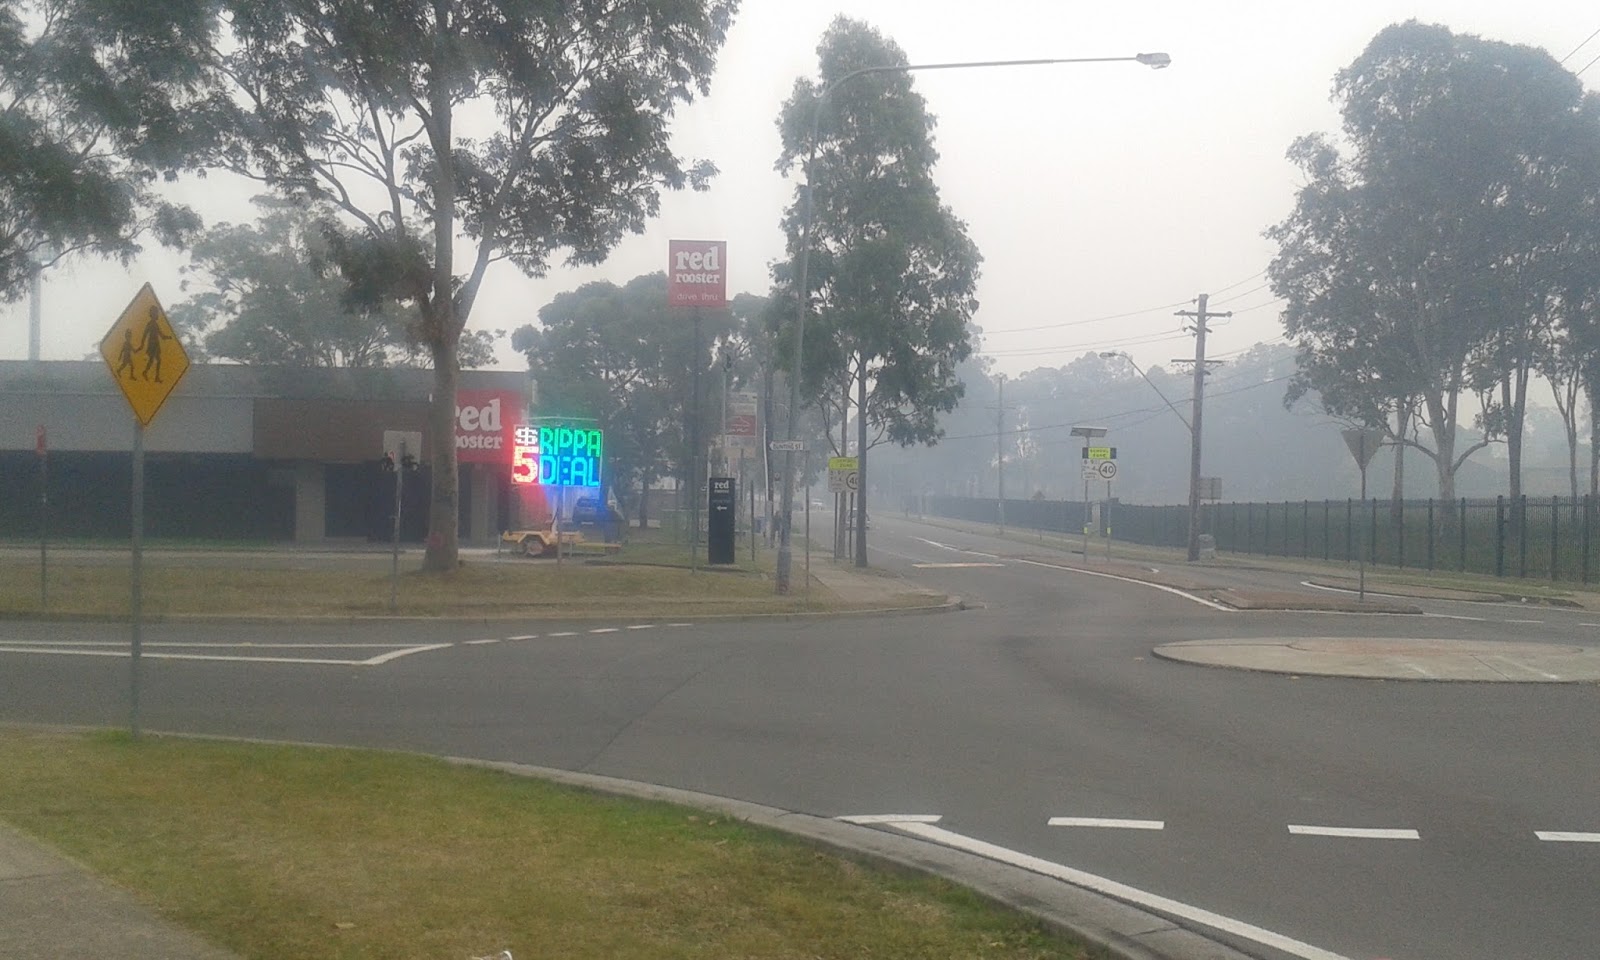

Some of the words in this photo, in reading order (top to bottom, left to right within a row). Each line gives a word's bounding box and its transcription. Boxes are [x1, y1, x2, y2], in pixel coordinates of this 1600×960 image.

[675, 246, 720, 271] red
[675, 272, 720, 284] rooster
[455, 434, 503, 449] oster
[515, 427, 538, 446] $
[539, 427, 601, 457] RIPPA
[513, 446, 539, 483] 5
[539, 456, 599, 486] DEAL
[1102, 465, 1114, 474] 40
[714, 480, 730, 489] red
